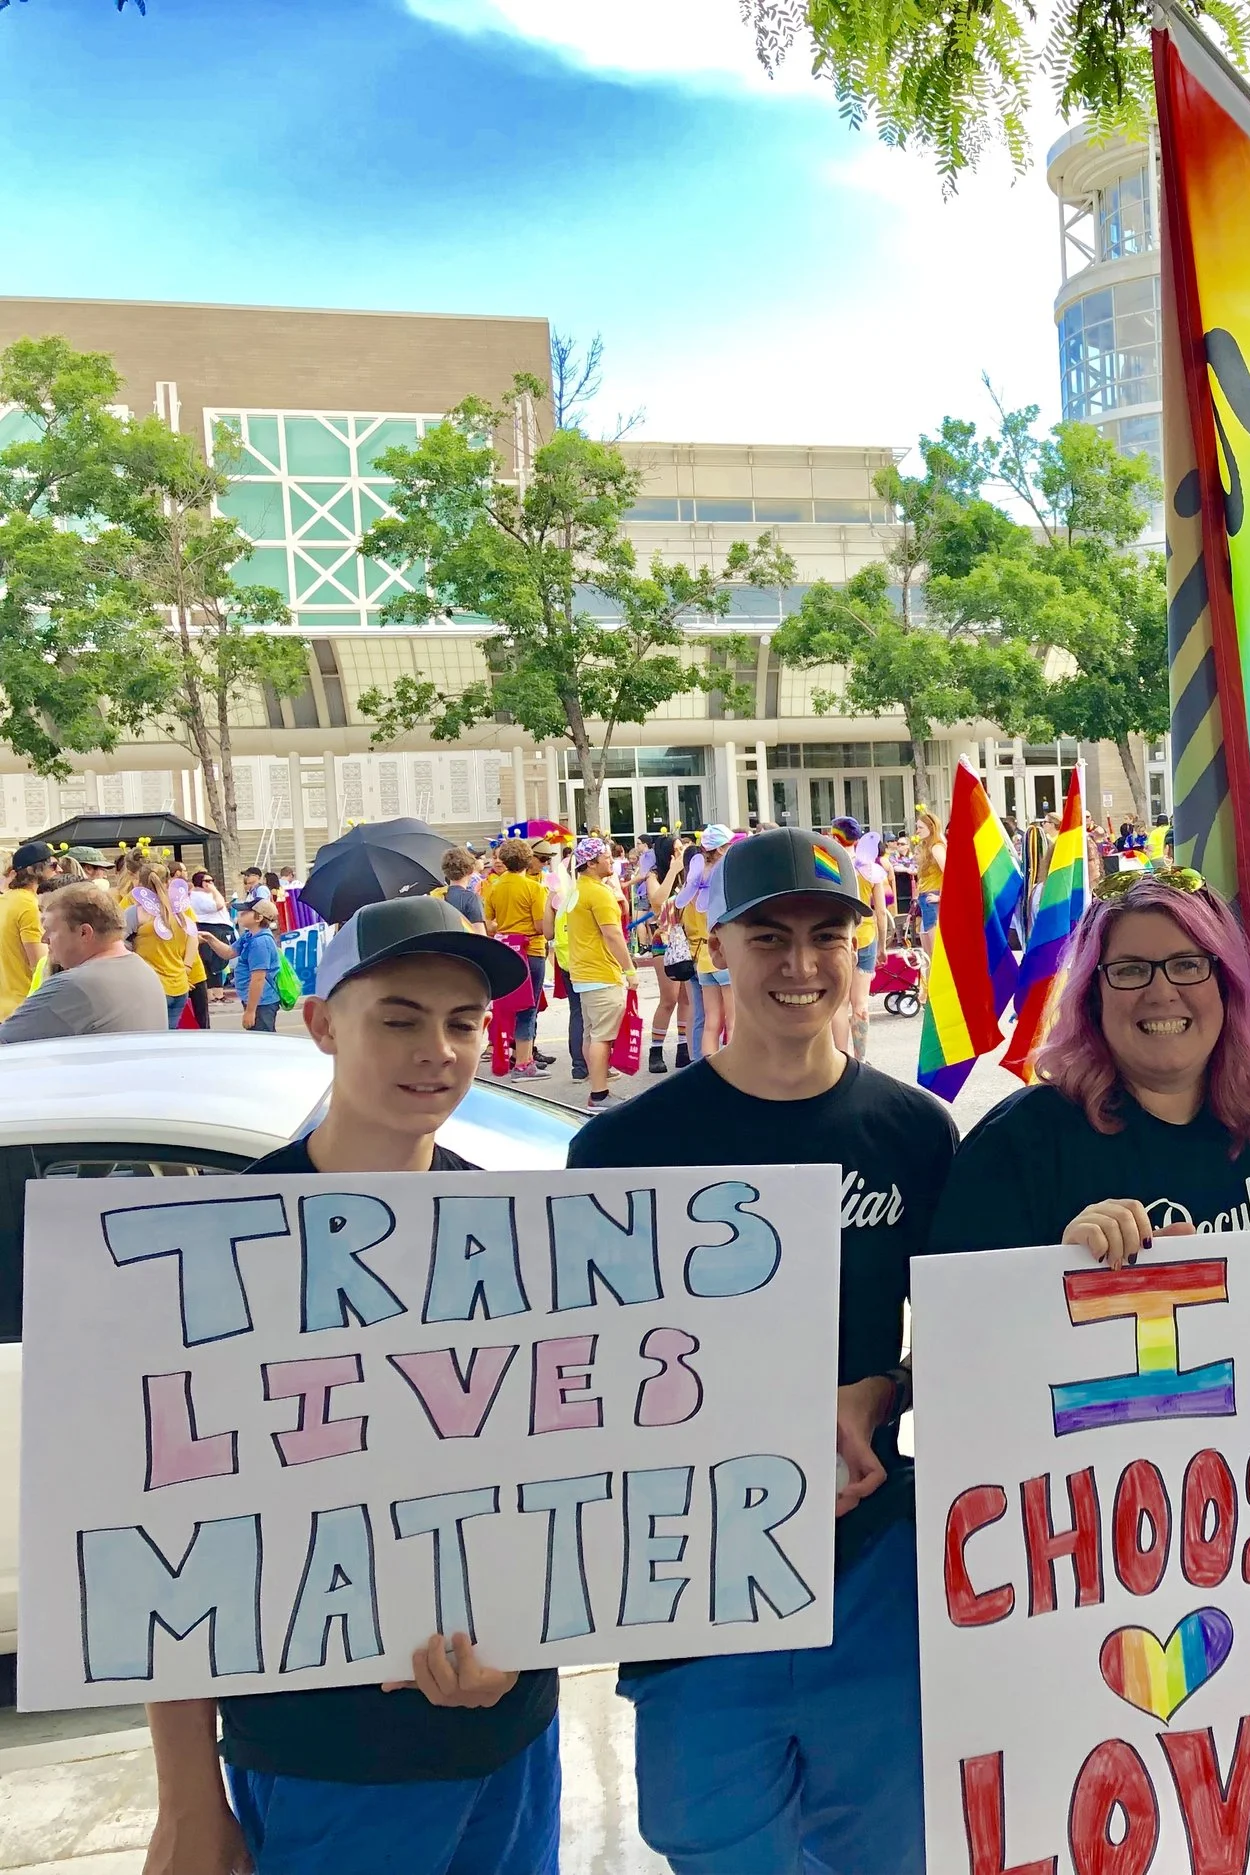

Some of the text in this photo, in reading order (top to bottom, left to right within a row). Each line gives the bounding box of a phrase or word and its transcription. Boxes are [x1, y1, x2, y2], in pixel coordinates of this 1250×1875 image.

[100, 1181, 782, 1347] TRANS
[1049, 1257, 1237, 1437] I
[142, 1328, 704, 1491] LIVES
[77, 1454, 816, 1683] MATTER
